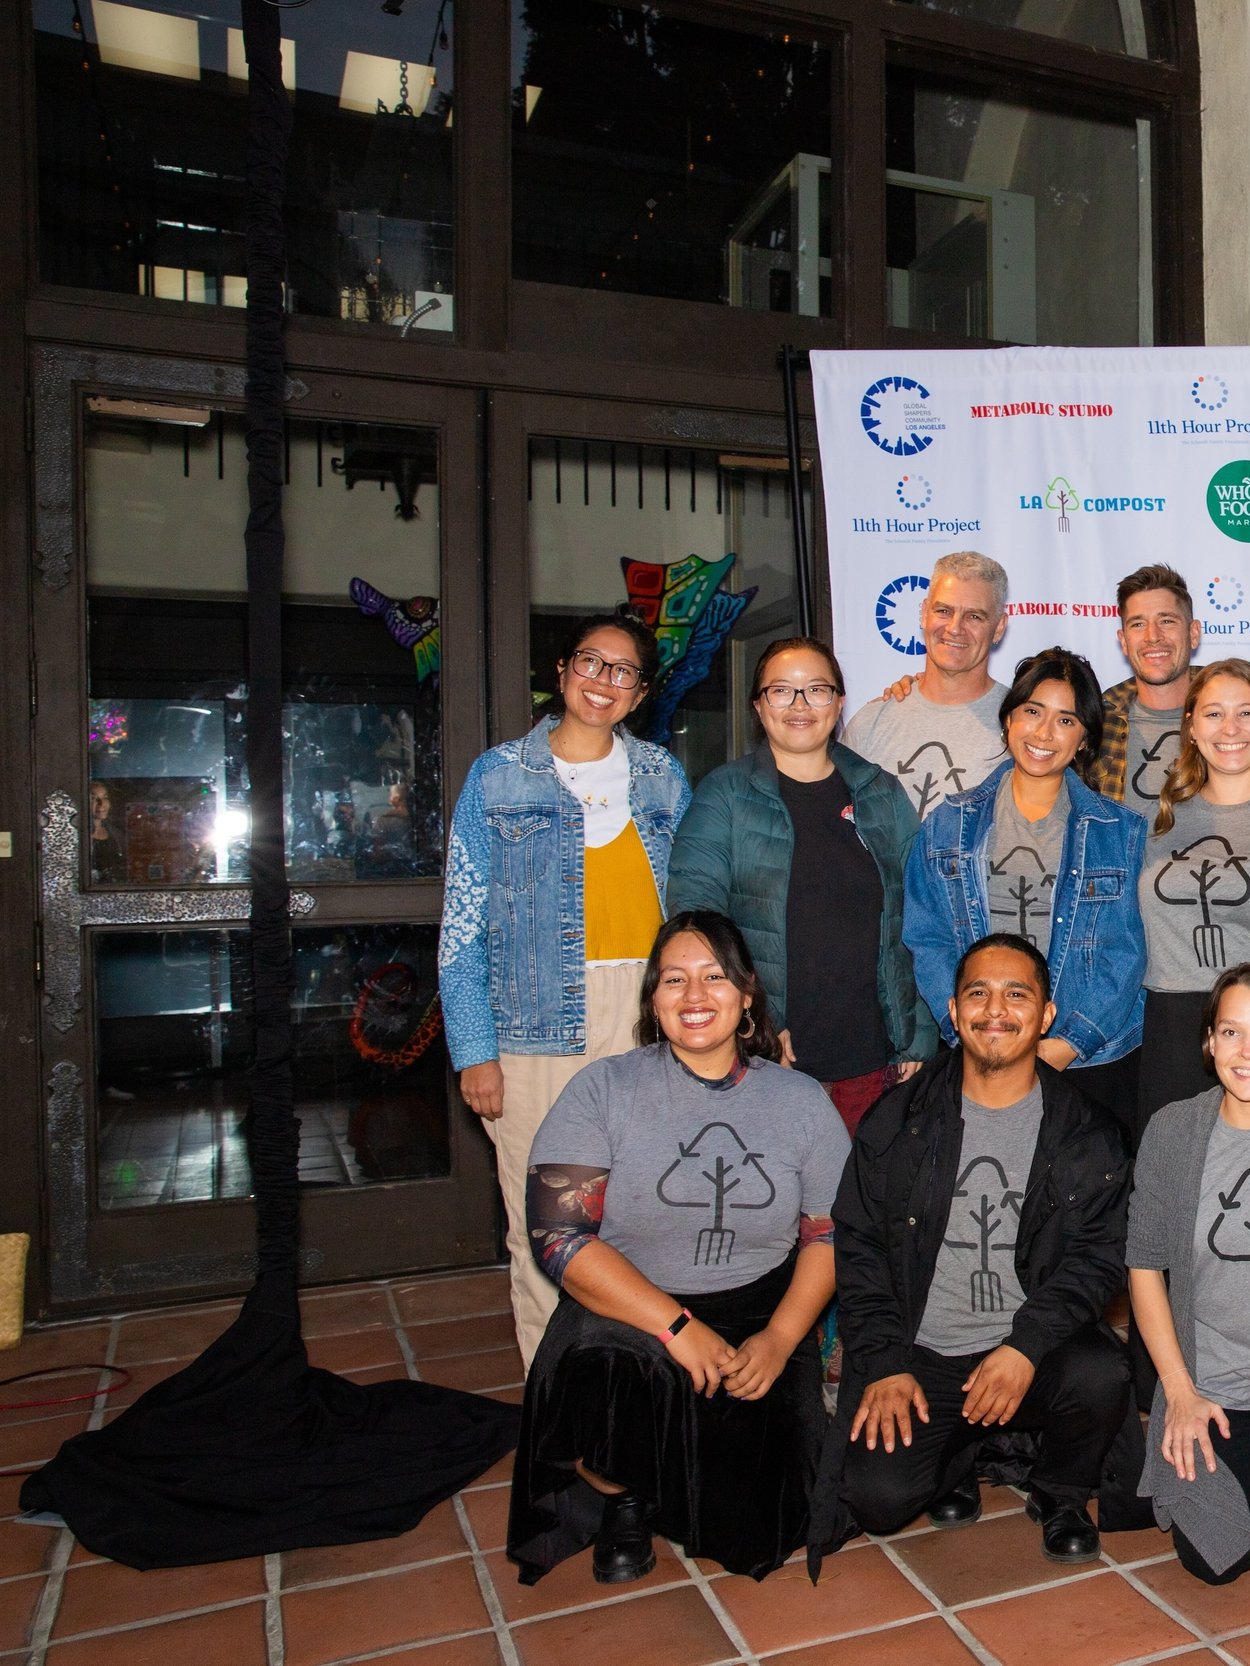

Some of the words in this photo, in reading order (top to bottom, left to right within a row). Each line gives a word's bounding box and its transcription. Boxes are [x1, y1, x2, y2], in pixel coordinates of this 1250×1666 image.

[971, 402, 1054, 418] METABOLIC
[1059, 404, 1113, 418] STUDIO
[1148, 420, 1177, 434] 11th
[1182, 421, 1221, 434] Hour
[1020, 496, 1043, 509] LA
[1084, 498, 1165, 512] COMPOST
[853, 518, 881, 532] 11th
[886, 519, 924, 532] Hour
[929, 518, 981, 535] Project
[1005, 602, 1068, 616] TABOLIC
[1201, 620, 1234, 634] Hour
